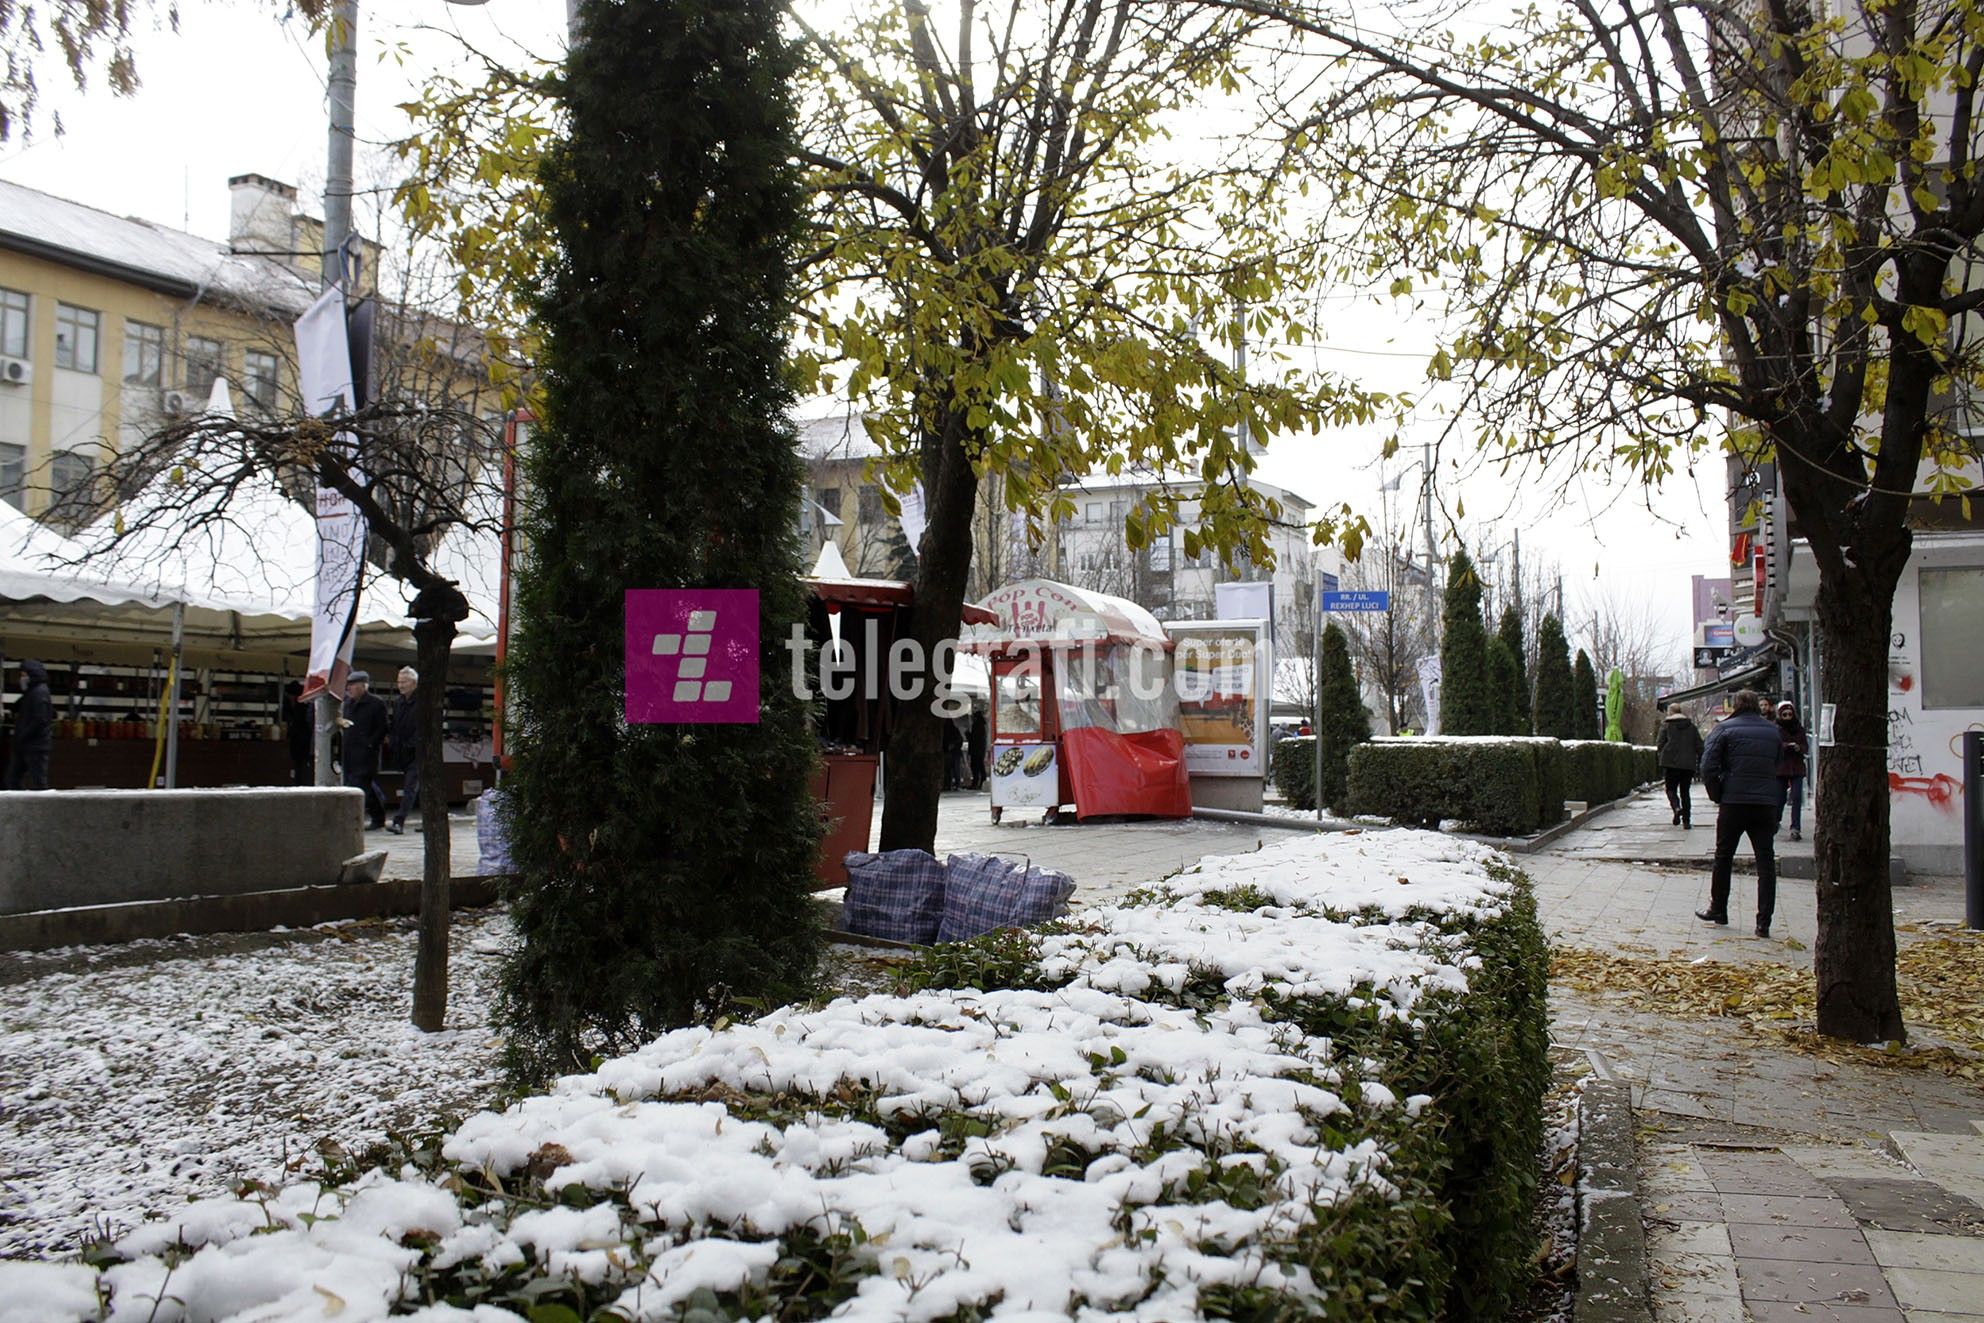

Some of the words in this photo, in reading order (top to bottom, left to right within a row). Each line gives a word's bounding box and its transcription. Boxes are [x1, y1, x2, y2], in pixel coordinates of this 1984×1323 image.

[1330, 602, 1360, 610] REXHEP
[1361, 602, 1379, 610] LUCI
[1183, 637, 1212, 648] Super
